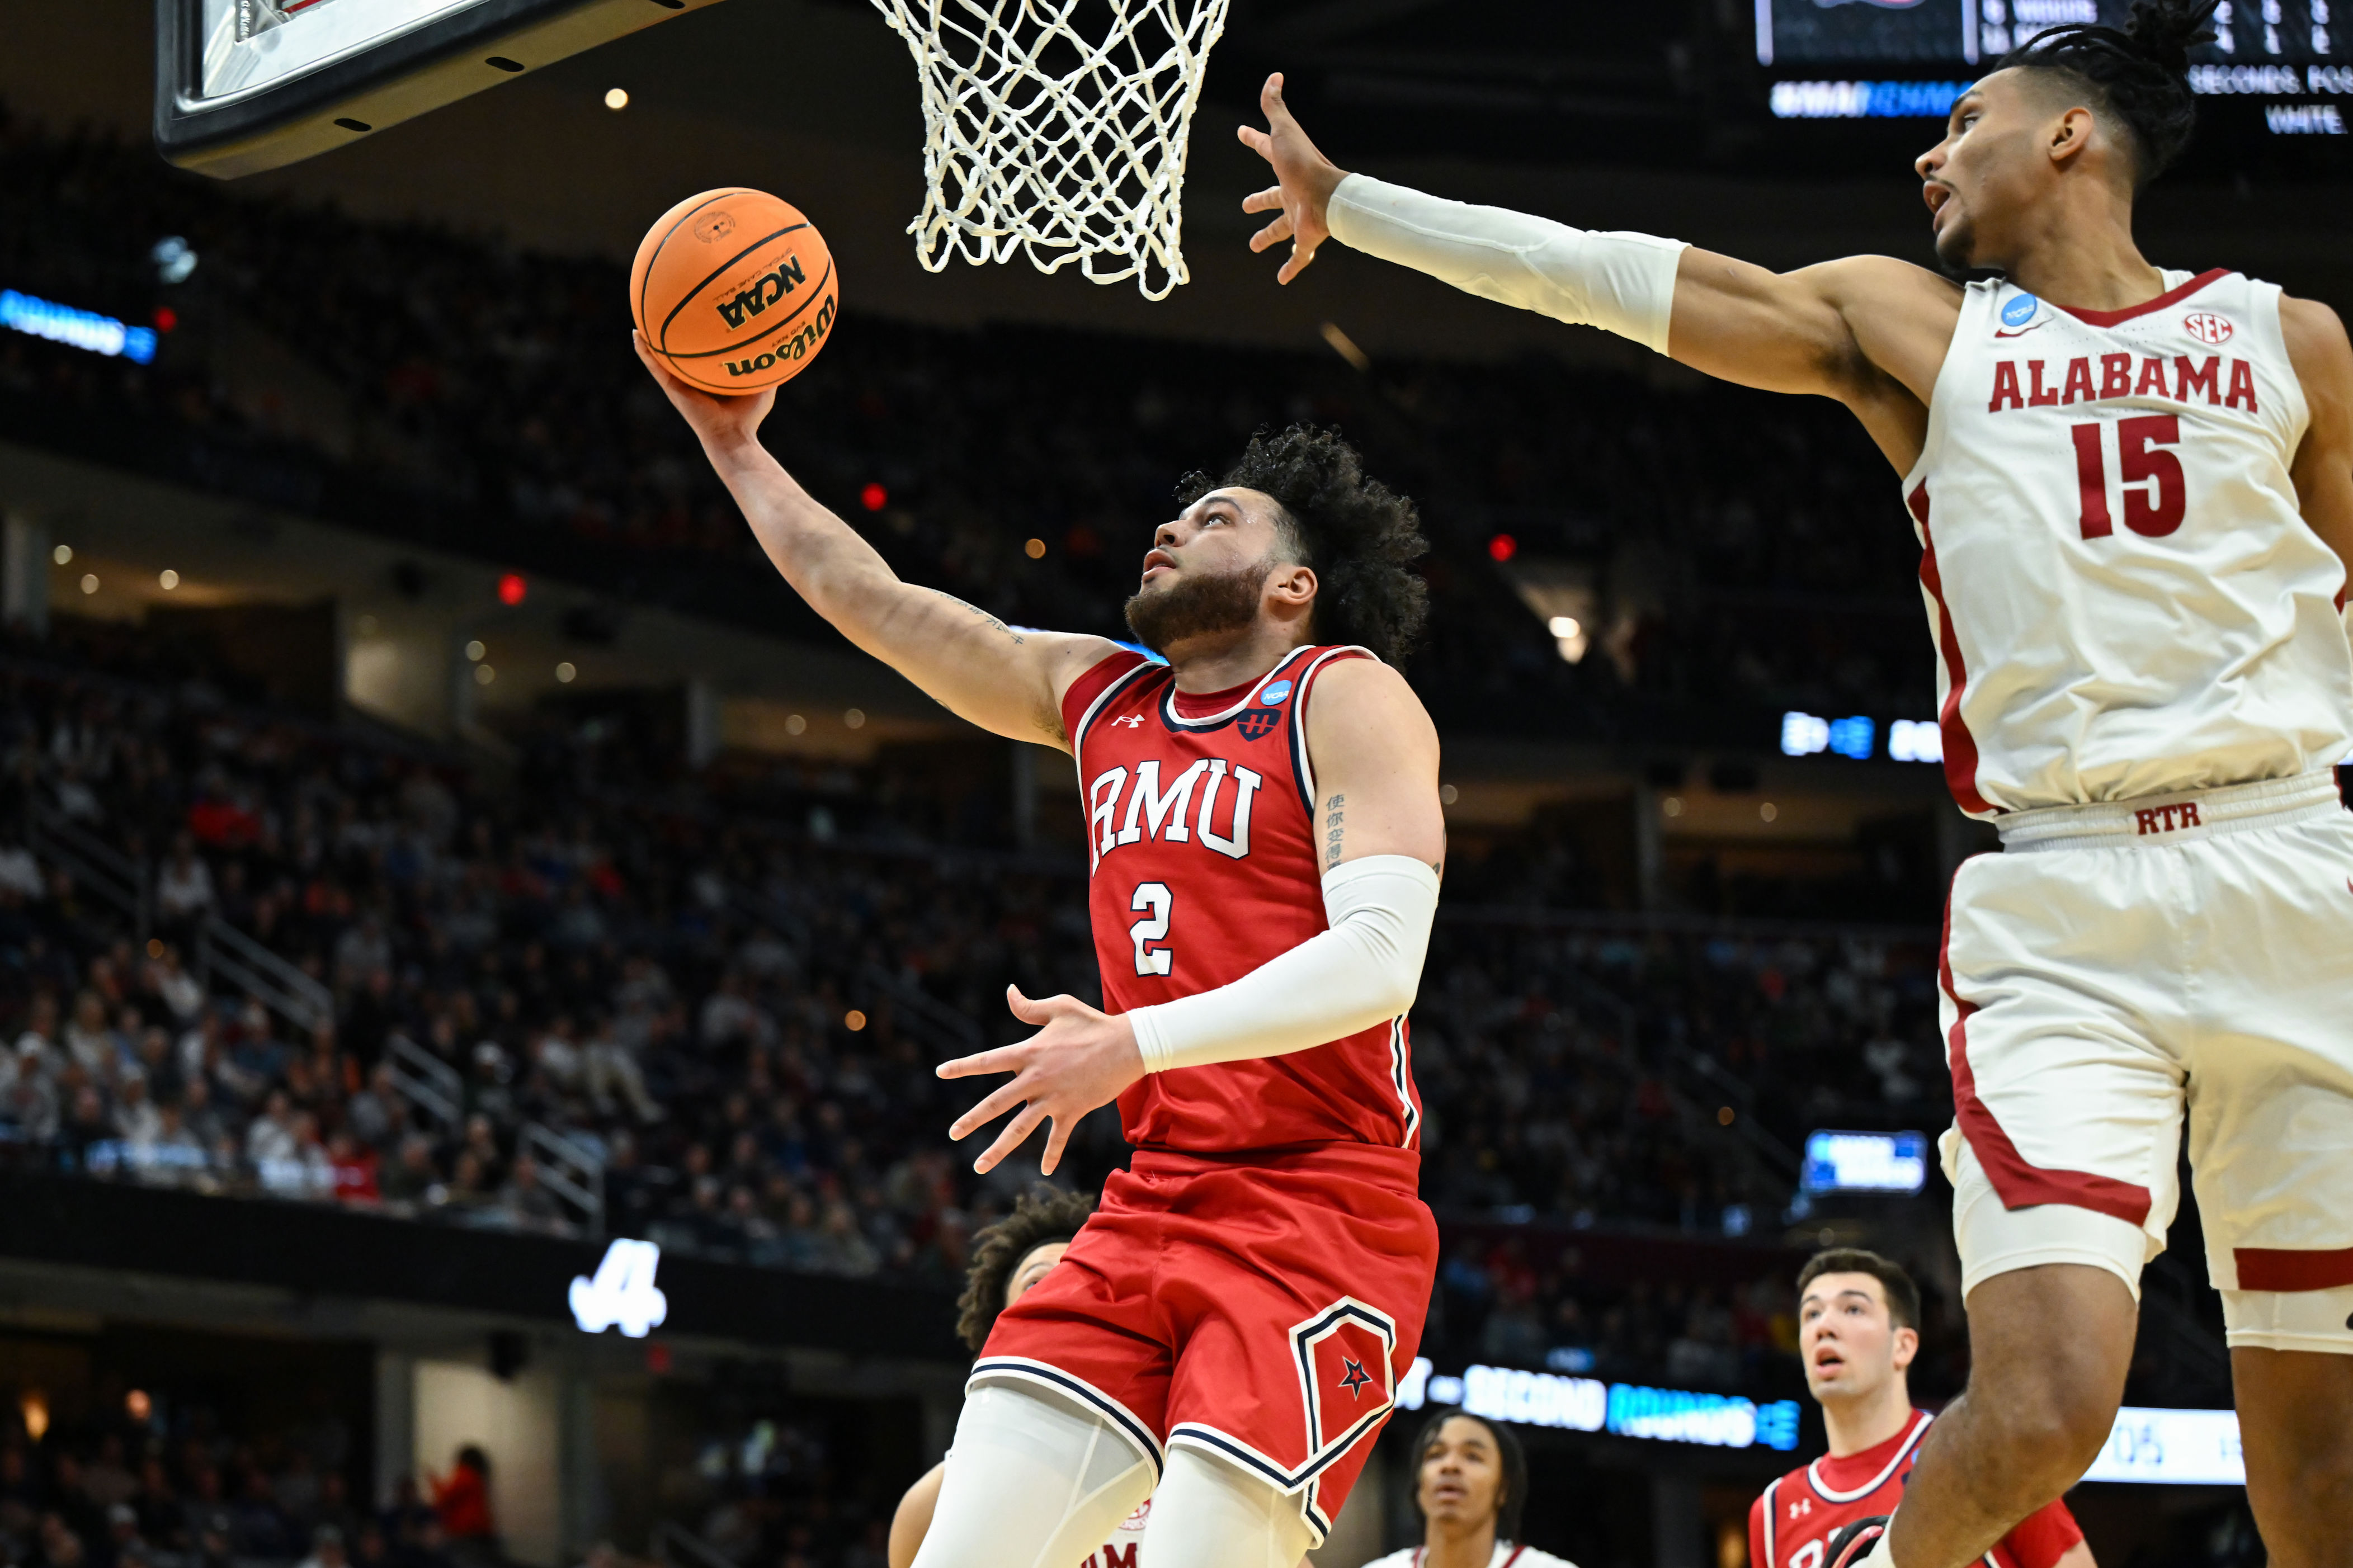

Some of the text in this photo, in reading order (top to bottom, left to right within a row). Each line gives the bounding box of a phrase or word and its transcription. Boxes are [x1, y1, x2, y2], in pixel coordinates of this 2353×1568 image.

[715, 253, 806, 330] NCAA
[2186, 314, 2231, 343] SEC
[724, 294, 835, 376] Wilson
[1988, 352, 2257, 414] ALABAMA
[2071, 414, 2186, 540] 15
[1263, 690, 1289, 700] NCAA
[1090, 758, 1262, 878] RMU
[2134, 802, 2201, 835] RTR
[1130, 881, 1173, 977] 2
